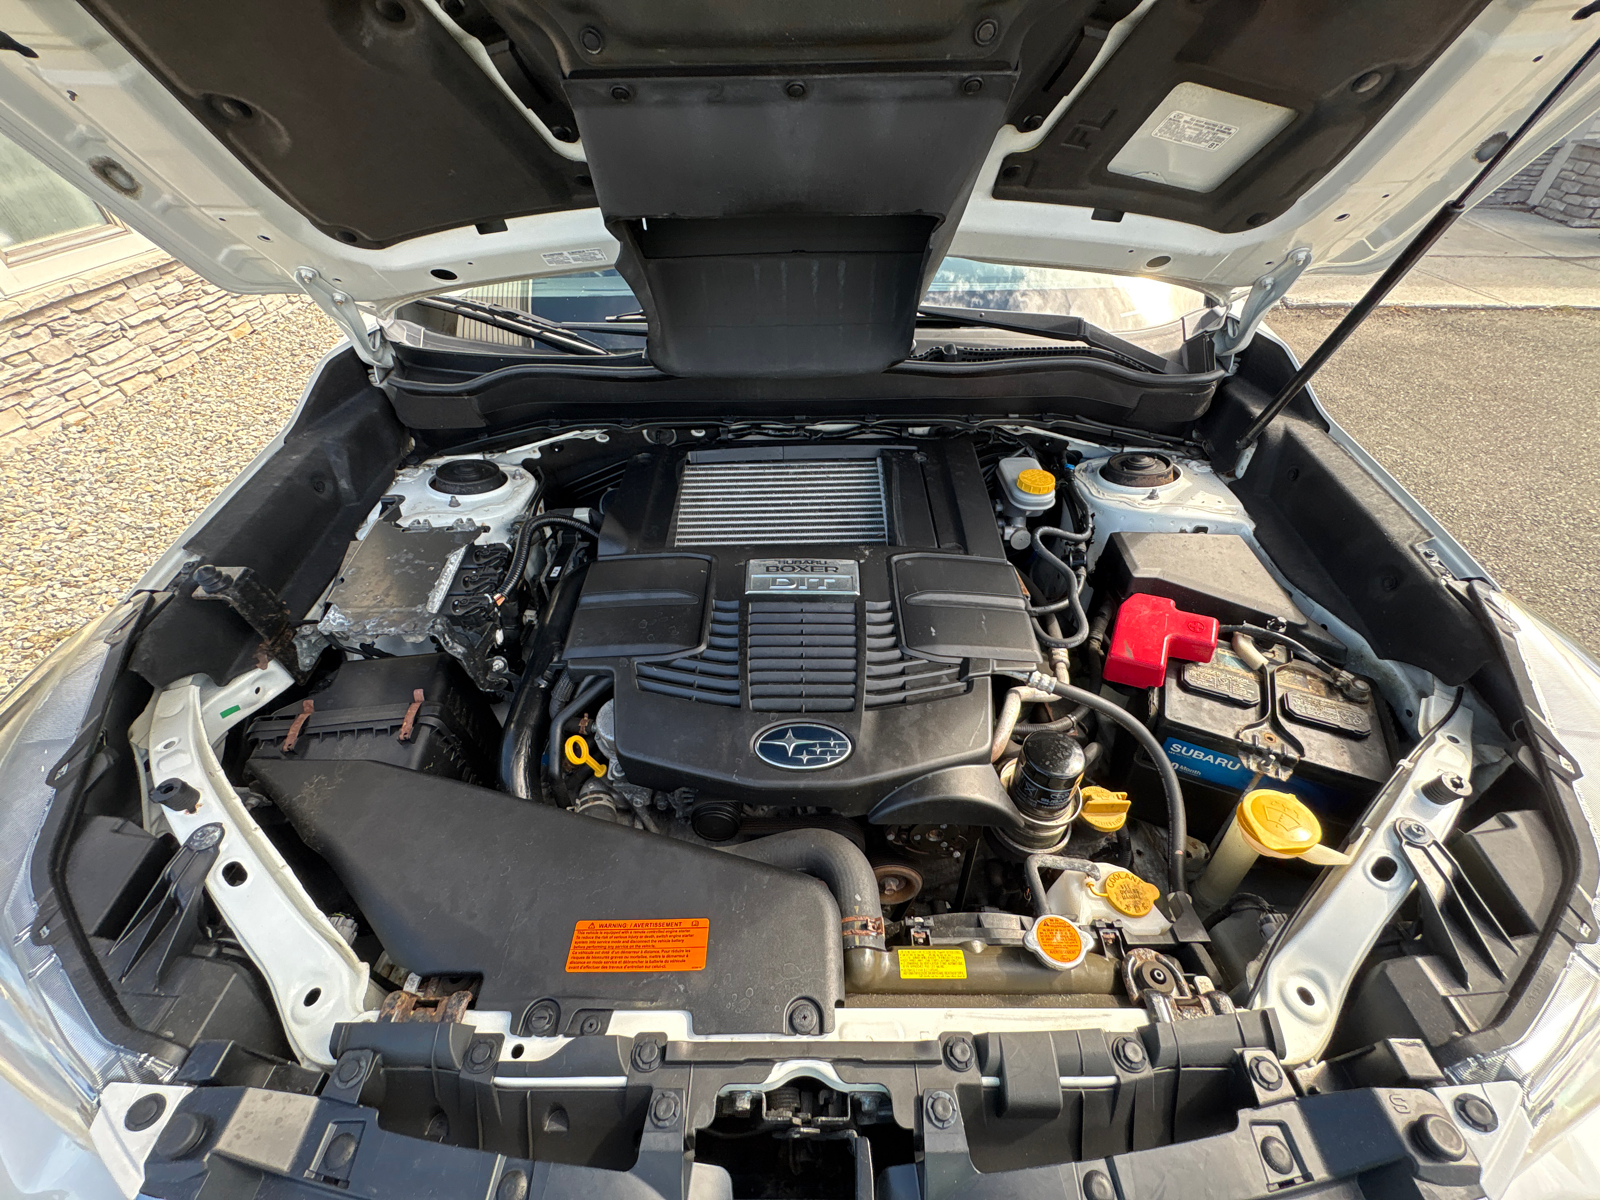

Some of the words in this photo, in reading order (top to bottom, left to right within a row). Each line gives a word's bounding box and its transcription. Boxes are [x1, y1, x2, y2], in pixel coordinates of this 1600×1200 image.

[769, 577, 836, 590] DIT
[1169, 742, 1242, 771] SUBARU
[1178, 765, 1202, 776] Month
[1107, 874, 1144, 888] COOLANT
[1388, 1094, 1411, 1114] S
